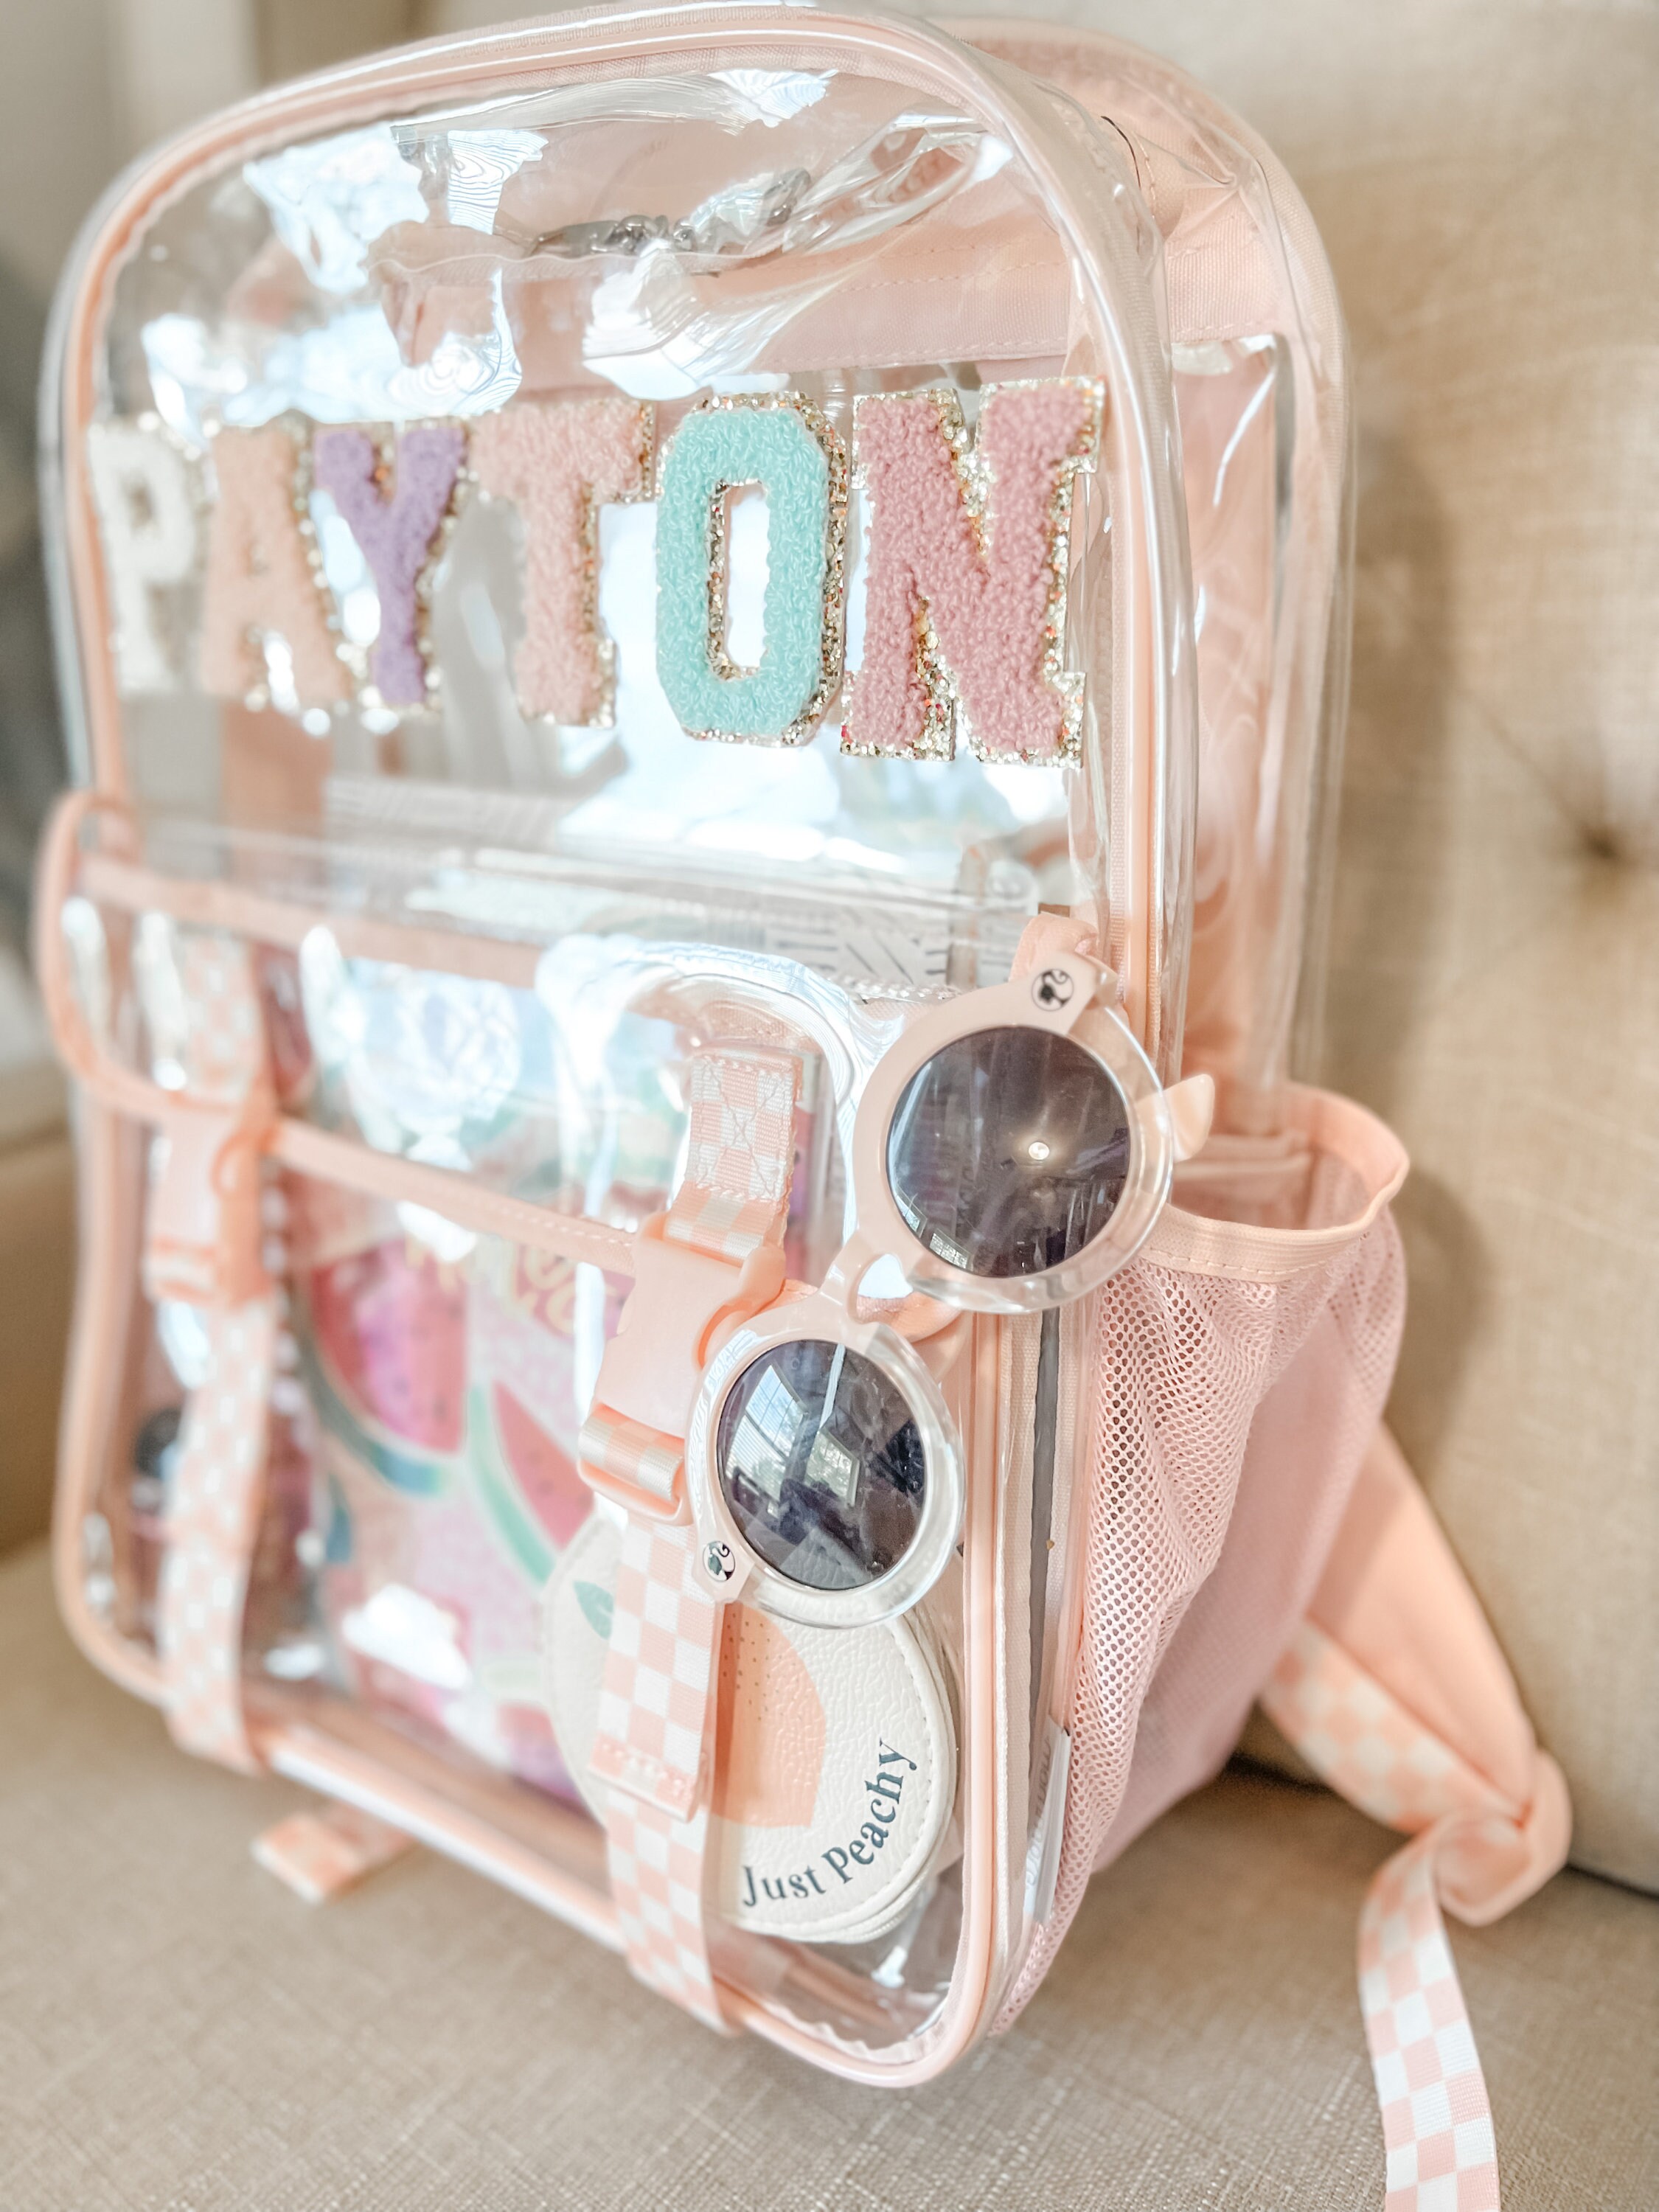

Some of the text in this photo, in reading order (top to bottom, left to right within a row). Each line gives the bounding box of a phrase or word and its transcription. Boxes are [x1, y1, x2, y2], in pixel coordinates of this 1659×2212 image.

[86, 378, 1106, 768] PAYTON
[742, 1865, 827, 1907] Just
[821, 1737, 917, 1884] Peachy
